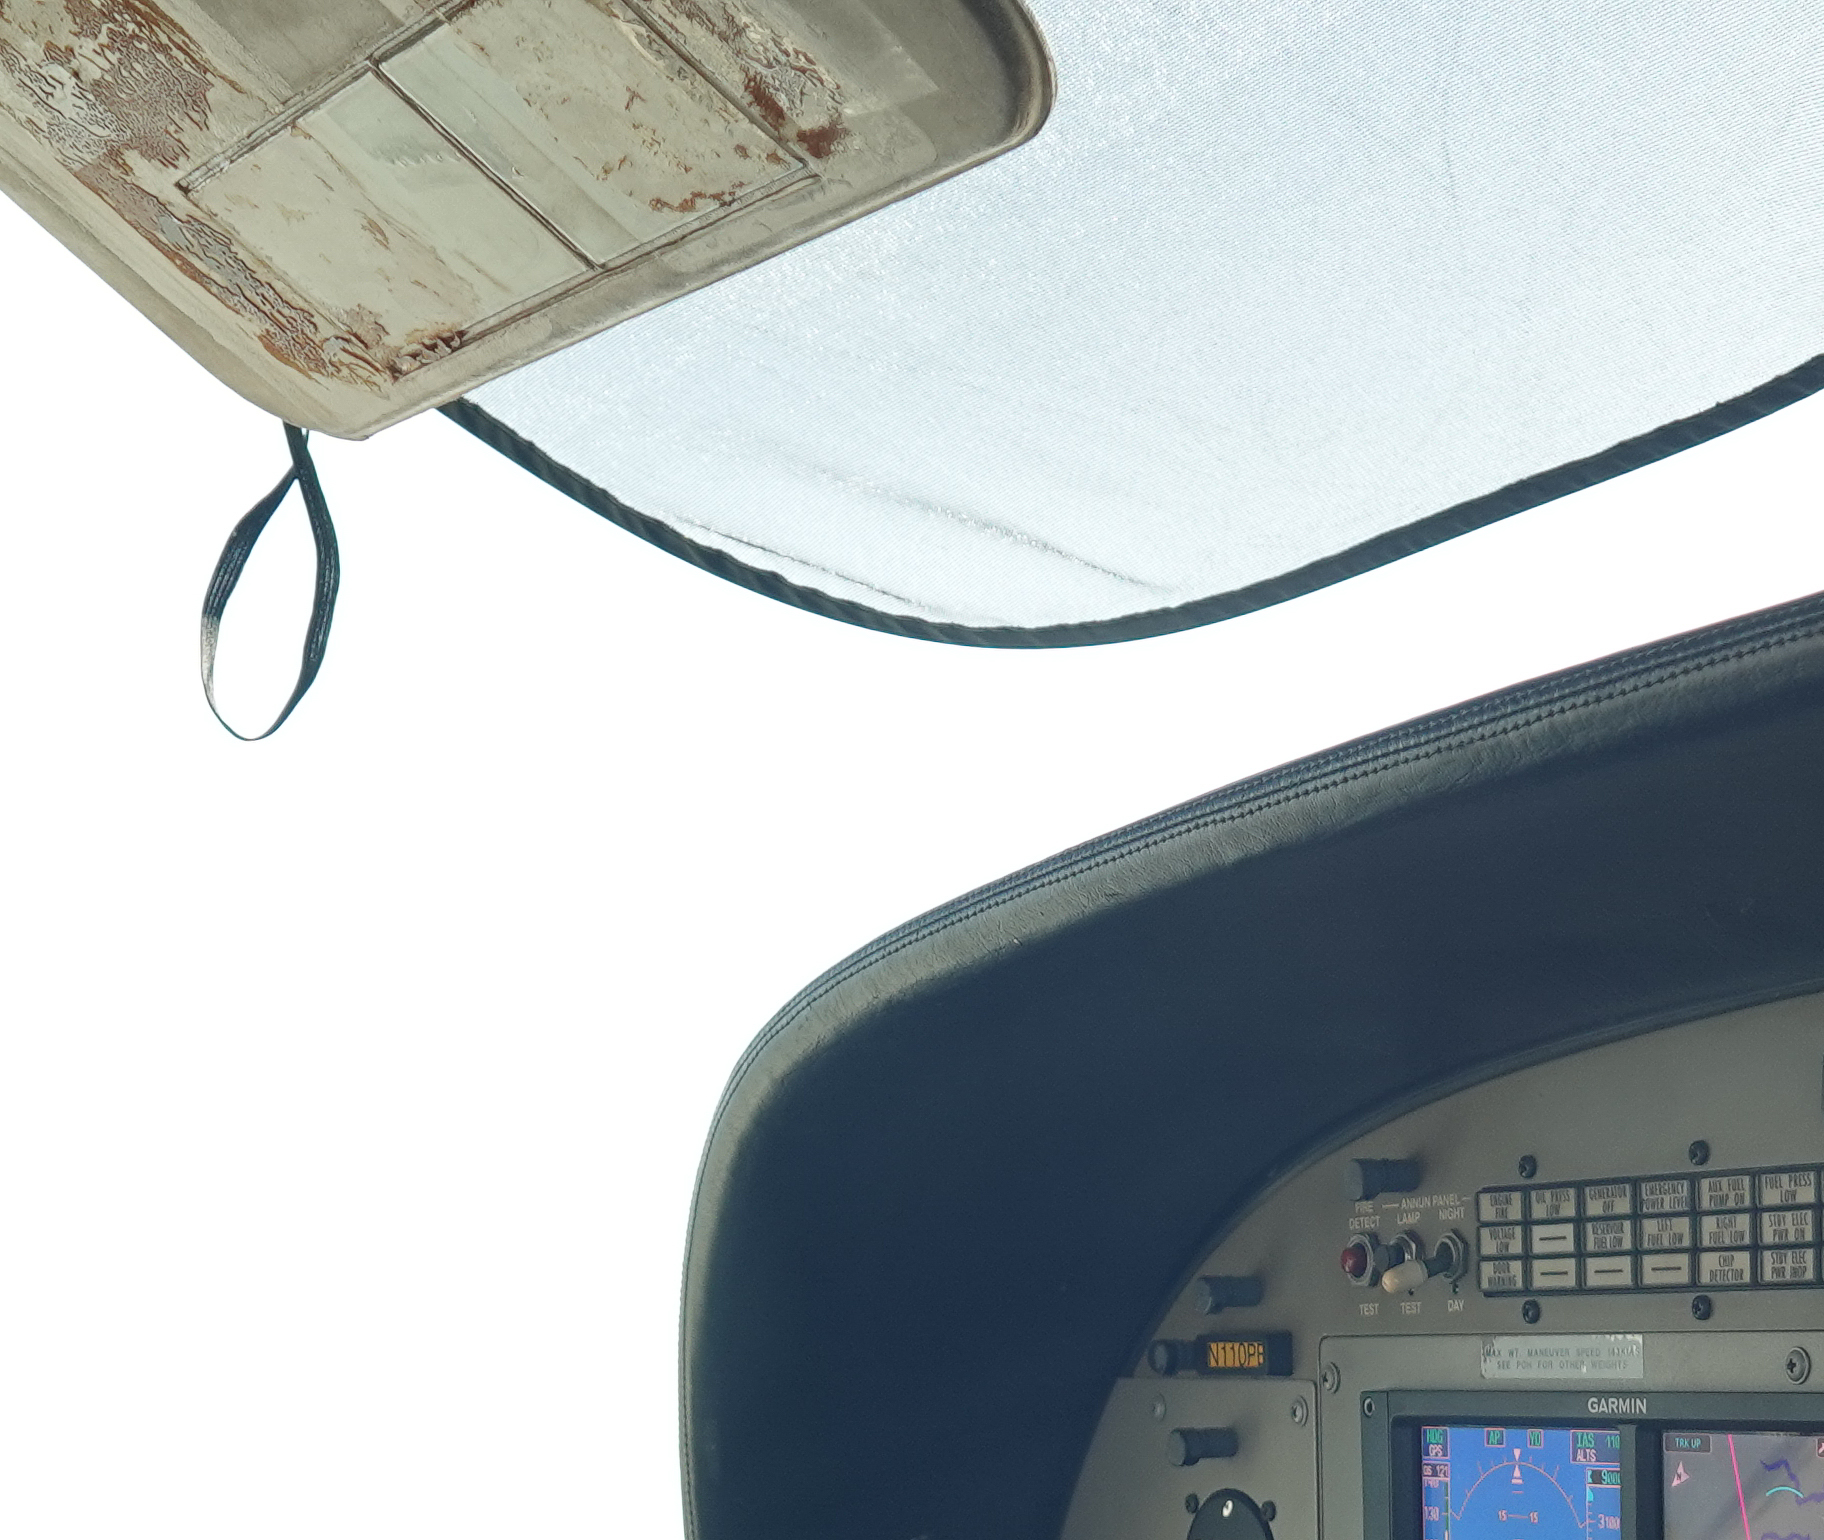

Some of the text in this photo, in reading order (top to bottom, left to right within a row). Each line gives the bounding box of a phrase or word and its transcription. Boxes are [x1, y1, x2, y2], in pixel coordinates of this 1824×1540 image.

[1644, 1180, 1685, 1197] EMERGENCY
[1765, 1173, 1812, 1190] FUEL PRESS
[1432, 1194, 1461, 1207] PANEL
[1779, 1189, 1797, 1203] LOW
[1438, 1206, 1465, 1220] NIGHT
[1601, 1201, 1615, 1213] OFF
[1397, 1211, 1421, 1225] LAMP
[1709, 1267, 1744, 1284] DETECTOR
[1359, 1303, 1380, 1316] TEST
[1400, 1301, 1421, 1315] TEST
[1447, 1299, 1465, 1311] DAY
[1587, 1397, 1647, 1415] GARMIN
[1488, 1430, 1500, 1444] AP
[1576, 1433, 1595, 1448] IAS
[1576, 1449, 1597, 1462] ALTS
